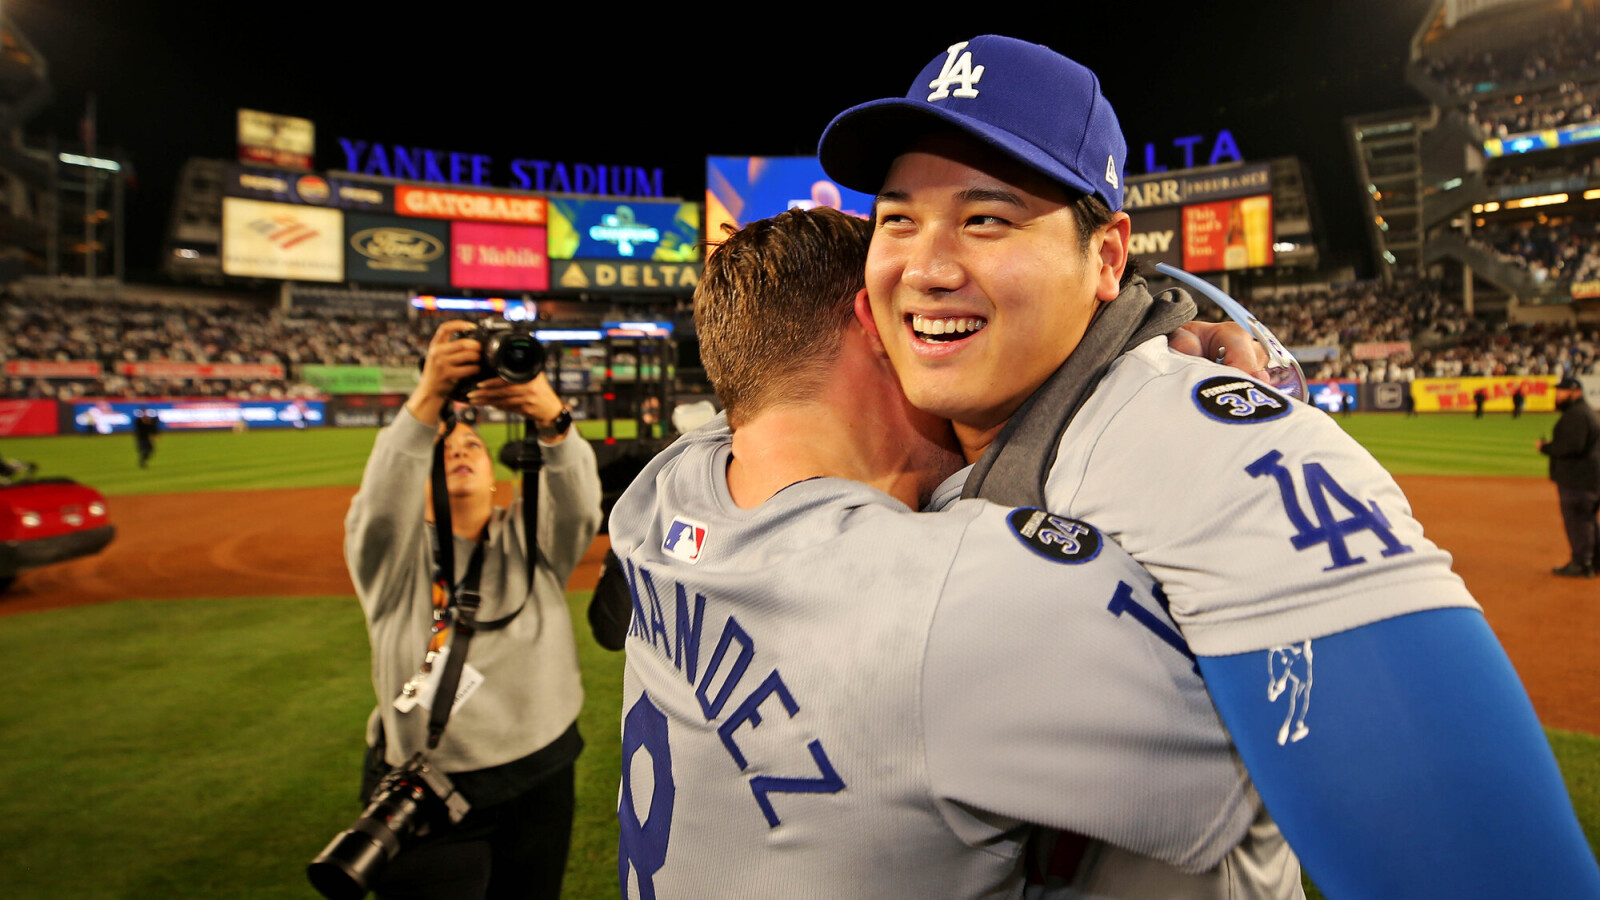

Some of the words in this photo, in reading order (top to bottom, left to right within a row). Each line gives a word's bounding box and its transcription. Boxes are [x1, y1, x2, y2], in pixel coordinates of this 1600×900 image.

[927, 41, 985, 102] LA
[338, 137, 493, 188] YANKEE
[510, 158, 663, 198] STADIUM
[1124, 129, 1243, 178] LTA
[404, 190, 543, 223] GATORADE
[1123, 179, 1181, 209] ARR
[1187, 170, 1268, 195] INSURANCE
[366, 229, 430, 261] Ford
[595, 264, 700, 288] DELTA
[1216, 388, 1282, 416] 34
[1244, 449, 1415, 572] LA
[1038, 516, 1089, 554] 34
